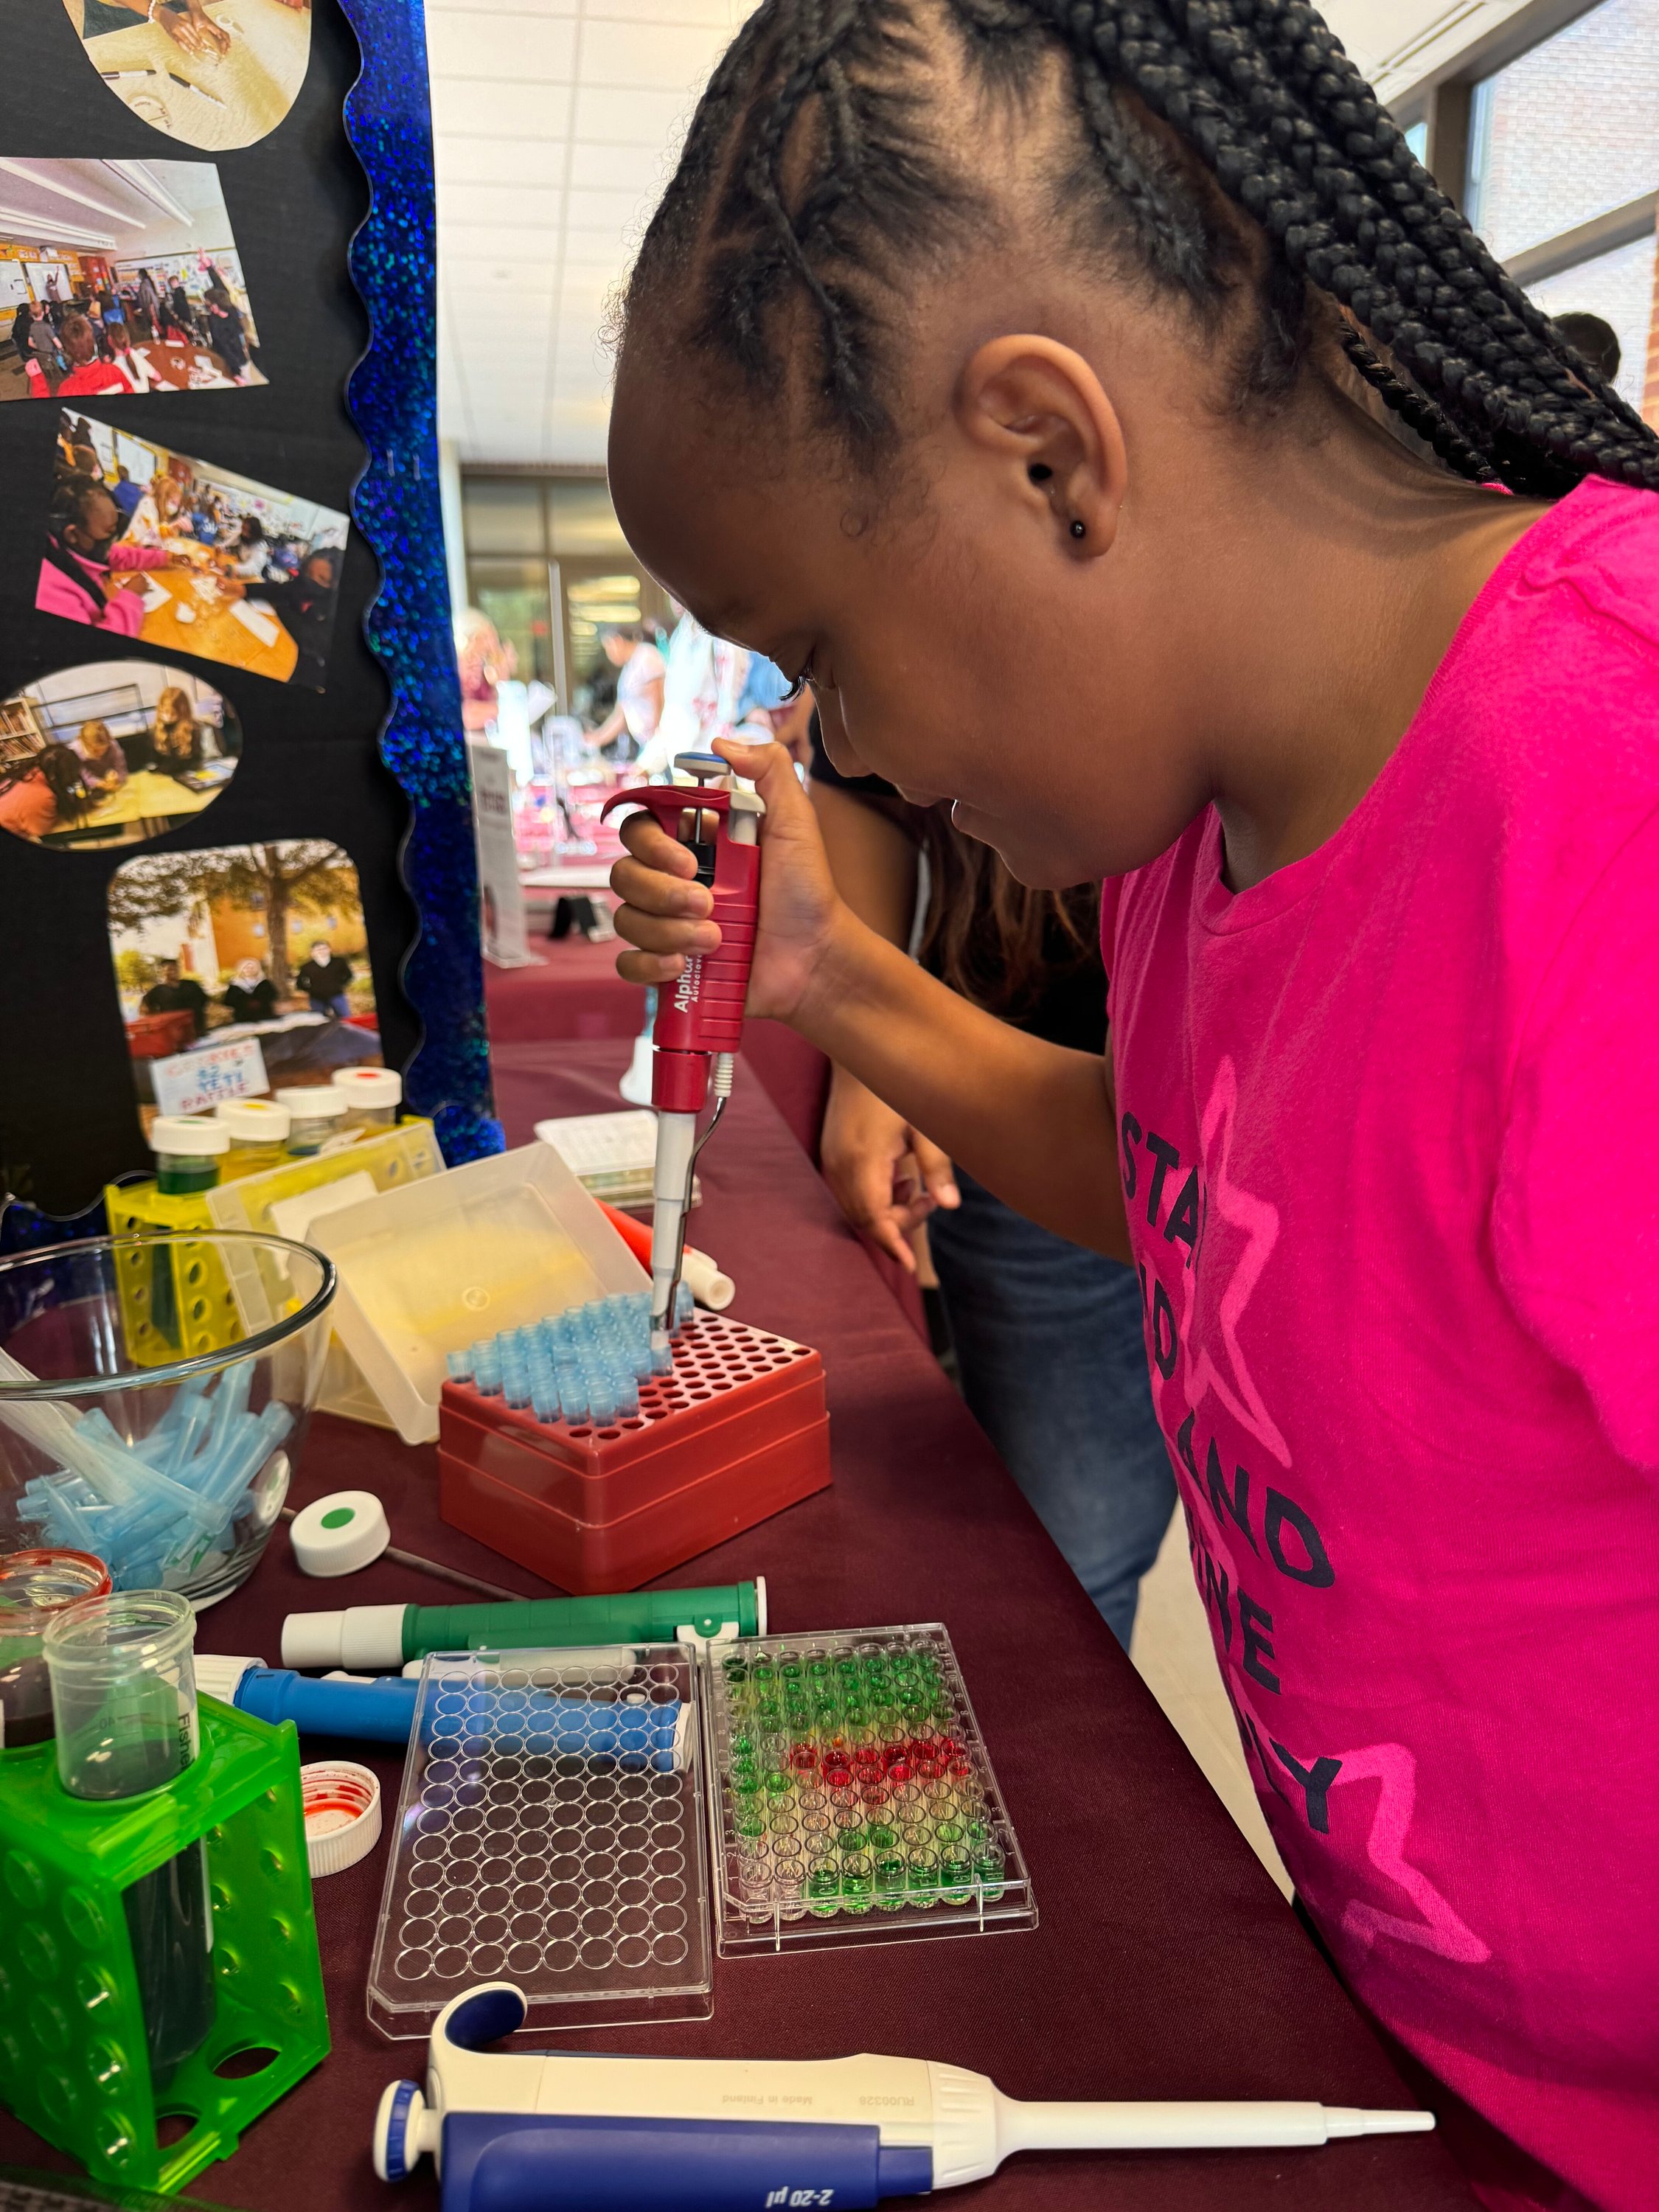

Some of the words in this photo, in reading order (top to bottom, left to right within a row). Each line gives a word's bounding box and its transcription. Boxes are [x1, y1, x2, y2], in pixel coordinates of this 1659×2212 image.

[1178, 1407, 1336, 1589] AND
[178, 1711, 193, 1766] Fishe
[722, 2094, 764, 2104] Finland
[768, 2095, 779, 2105] in
[782, 2095, 813, 2106] Made
[788, 2188, 835, 2208] 2-20
